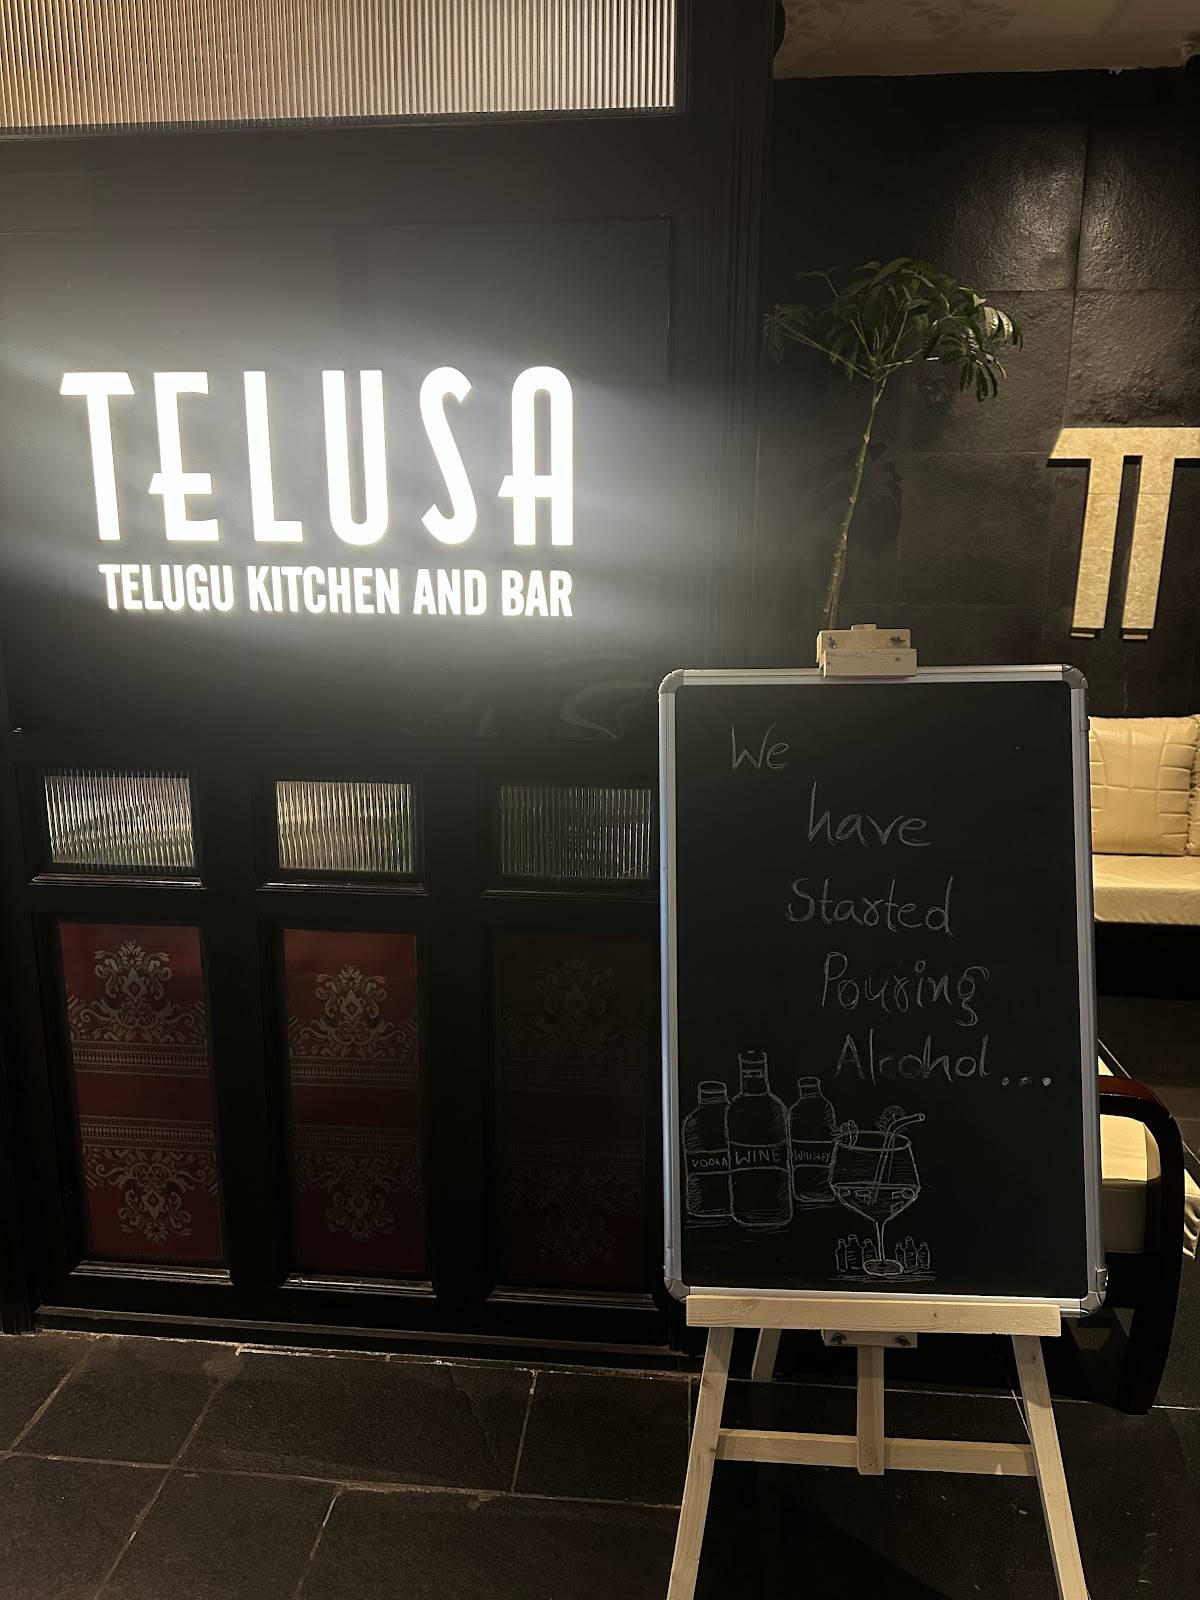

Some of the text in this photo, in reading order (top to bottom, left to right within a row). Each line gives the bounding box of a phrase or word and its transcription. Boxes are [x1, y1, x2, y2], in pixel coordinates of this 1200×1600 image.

[60, 366, 574, 546] TELUSA
[99, 563, 574, 618] TELUGU KITCHEN AND BAR
[731, 723, 790, 770] We
[807, 781, 933, 848] have
[785, 875, 956, 937] Started
[820, 951, 990, 1027] Pouring
[734, 1148, 782, 1165] WINE
